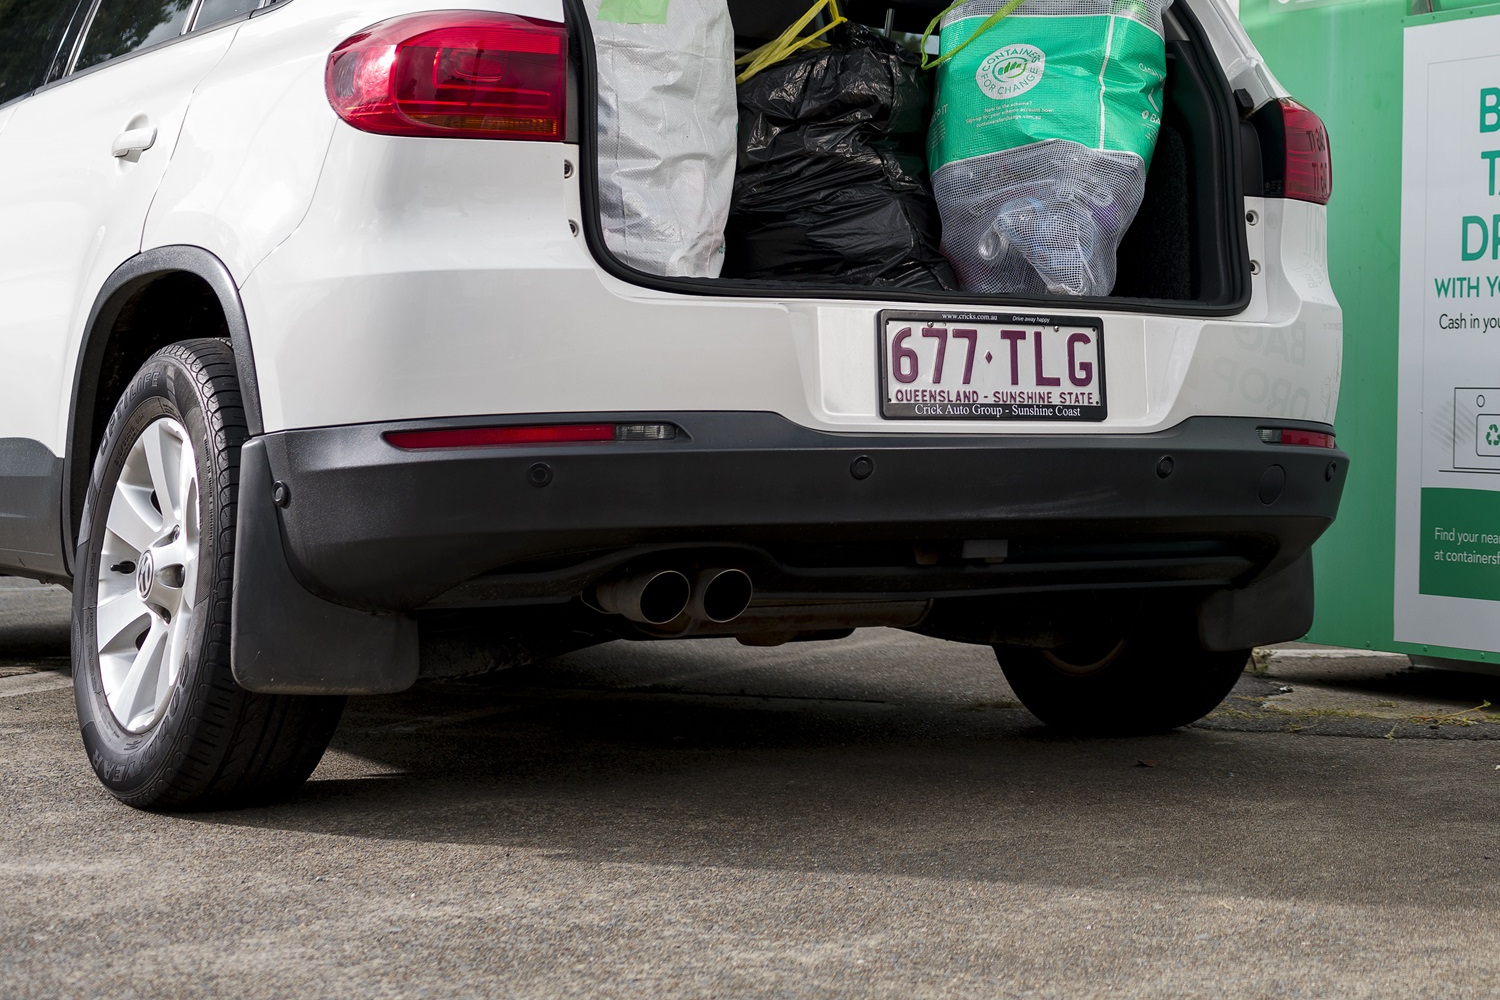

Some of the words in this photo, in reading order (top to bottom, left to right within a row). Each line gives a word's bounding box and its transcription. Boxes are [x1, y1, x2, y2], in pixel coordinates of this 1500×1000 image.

[981, 73, 996, 92] FOR
[997, 67, 1039, 95] CHANGE
[1434, 276, 1480, 298] WITH
[941, 313, 998, 321] www.cricks.com.au
[1439, 313, 1467, 330] Cash
[1470, 314, 1480, 329] in
[892, 327, 978, 385] 677
[1000, 329, 1093, 387] TLG
[895, 389, 979, 403] QUEENSLAND
[993, 391, 1053, 404] SUNSHINE
[1059, 391, 1093, 405] STATE
[915, 403, 943, 415] Crick
[945, 404, 970, 415] Auto
[972, 405, 1003, 418] Group
[1012, 404, 1053, 416] Sunshine
[1055, 406, 1081, 417] Coast
[1434, 527, 1455, 541] Find
[1457, 531, 1478, 545] your
[1434, 550, 1444, 561] at
